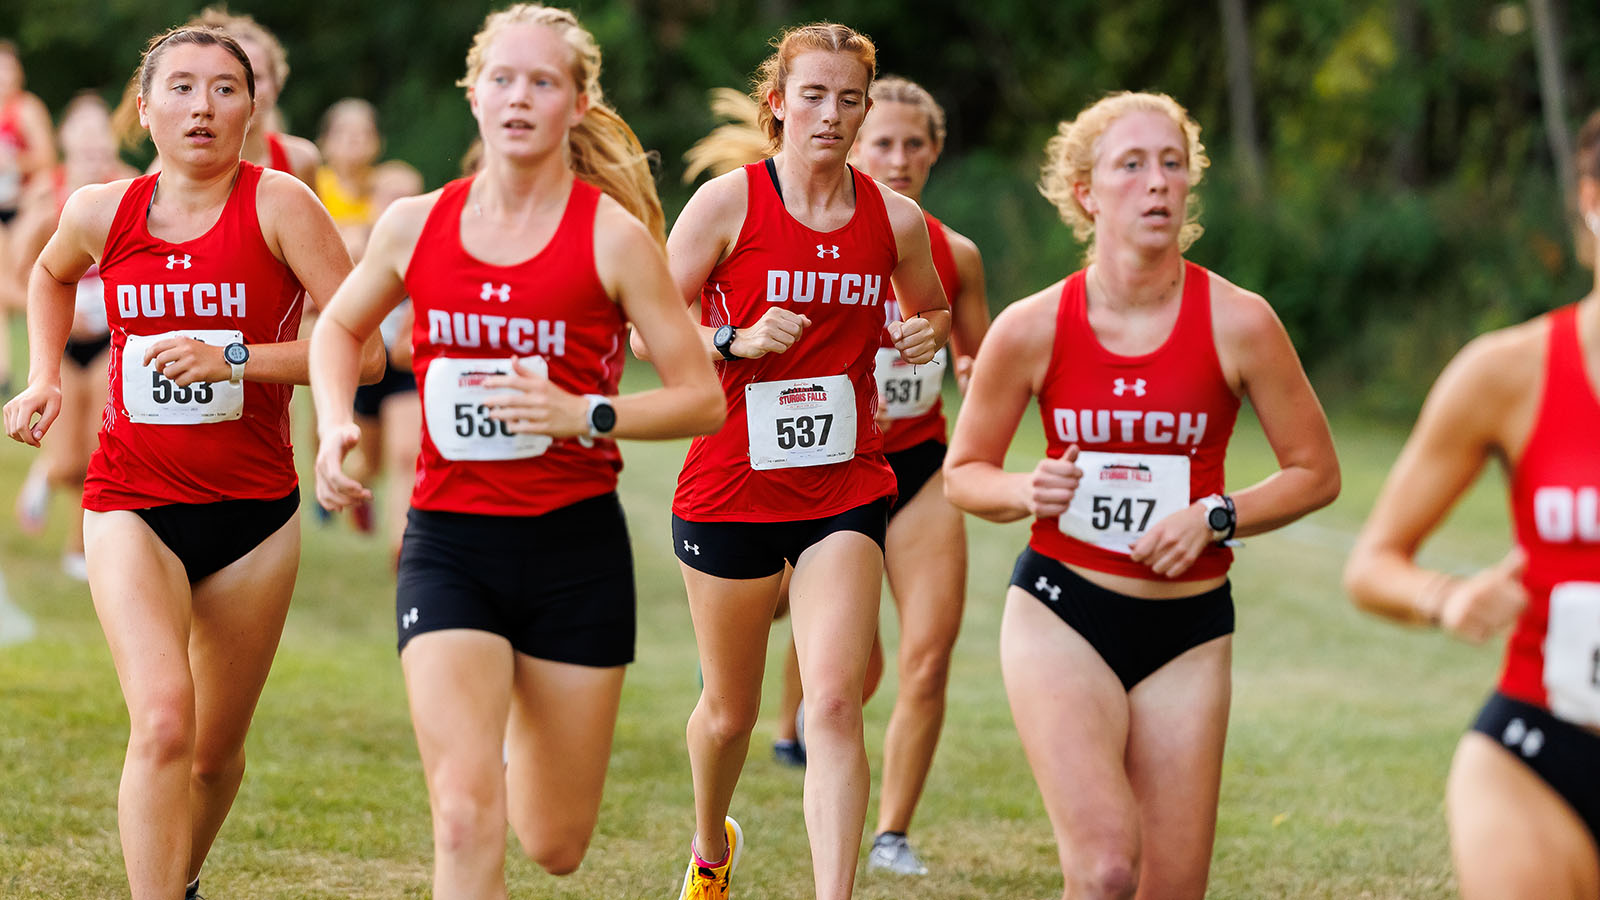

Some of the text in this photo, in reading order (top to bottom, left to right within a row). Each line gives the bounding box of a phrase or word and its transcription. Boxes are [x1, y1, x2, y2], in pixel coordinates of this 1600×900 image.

[116, 283, 246, 318] DUTCH
[766, 270, 881, 306] DUTCH
[428, 309, 566, 356] DUTCH
[779, 392, 827, 405] STURGIS FALLS
[885, 379, 922, 403] 531
[776, 414, 833, 449] 537
[1054, 408, 1207, 445] DUTCH
[1092, 496, 1156, 532] 547
